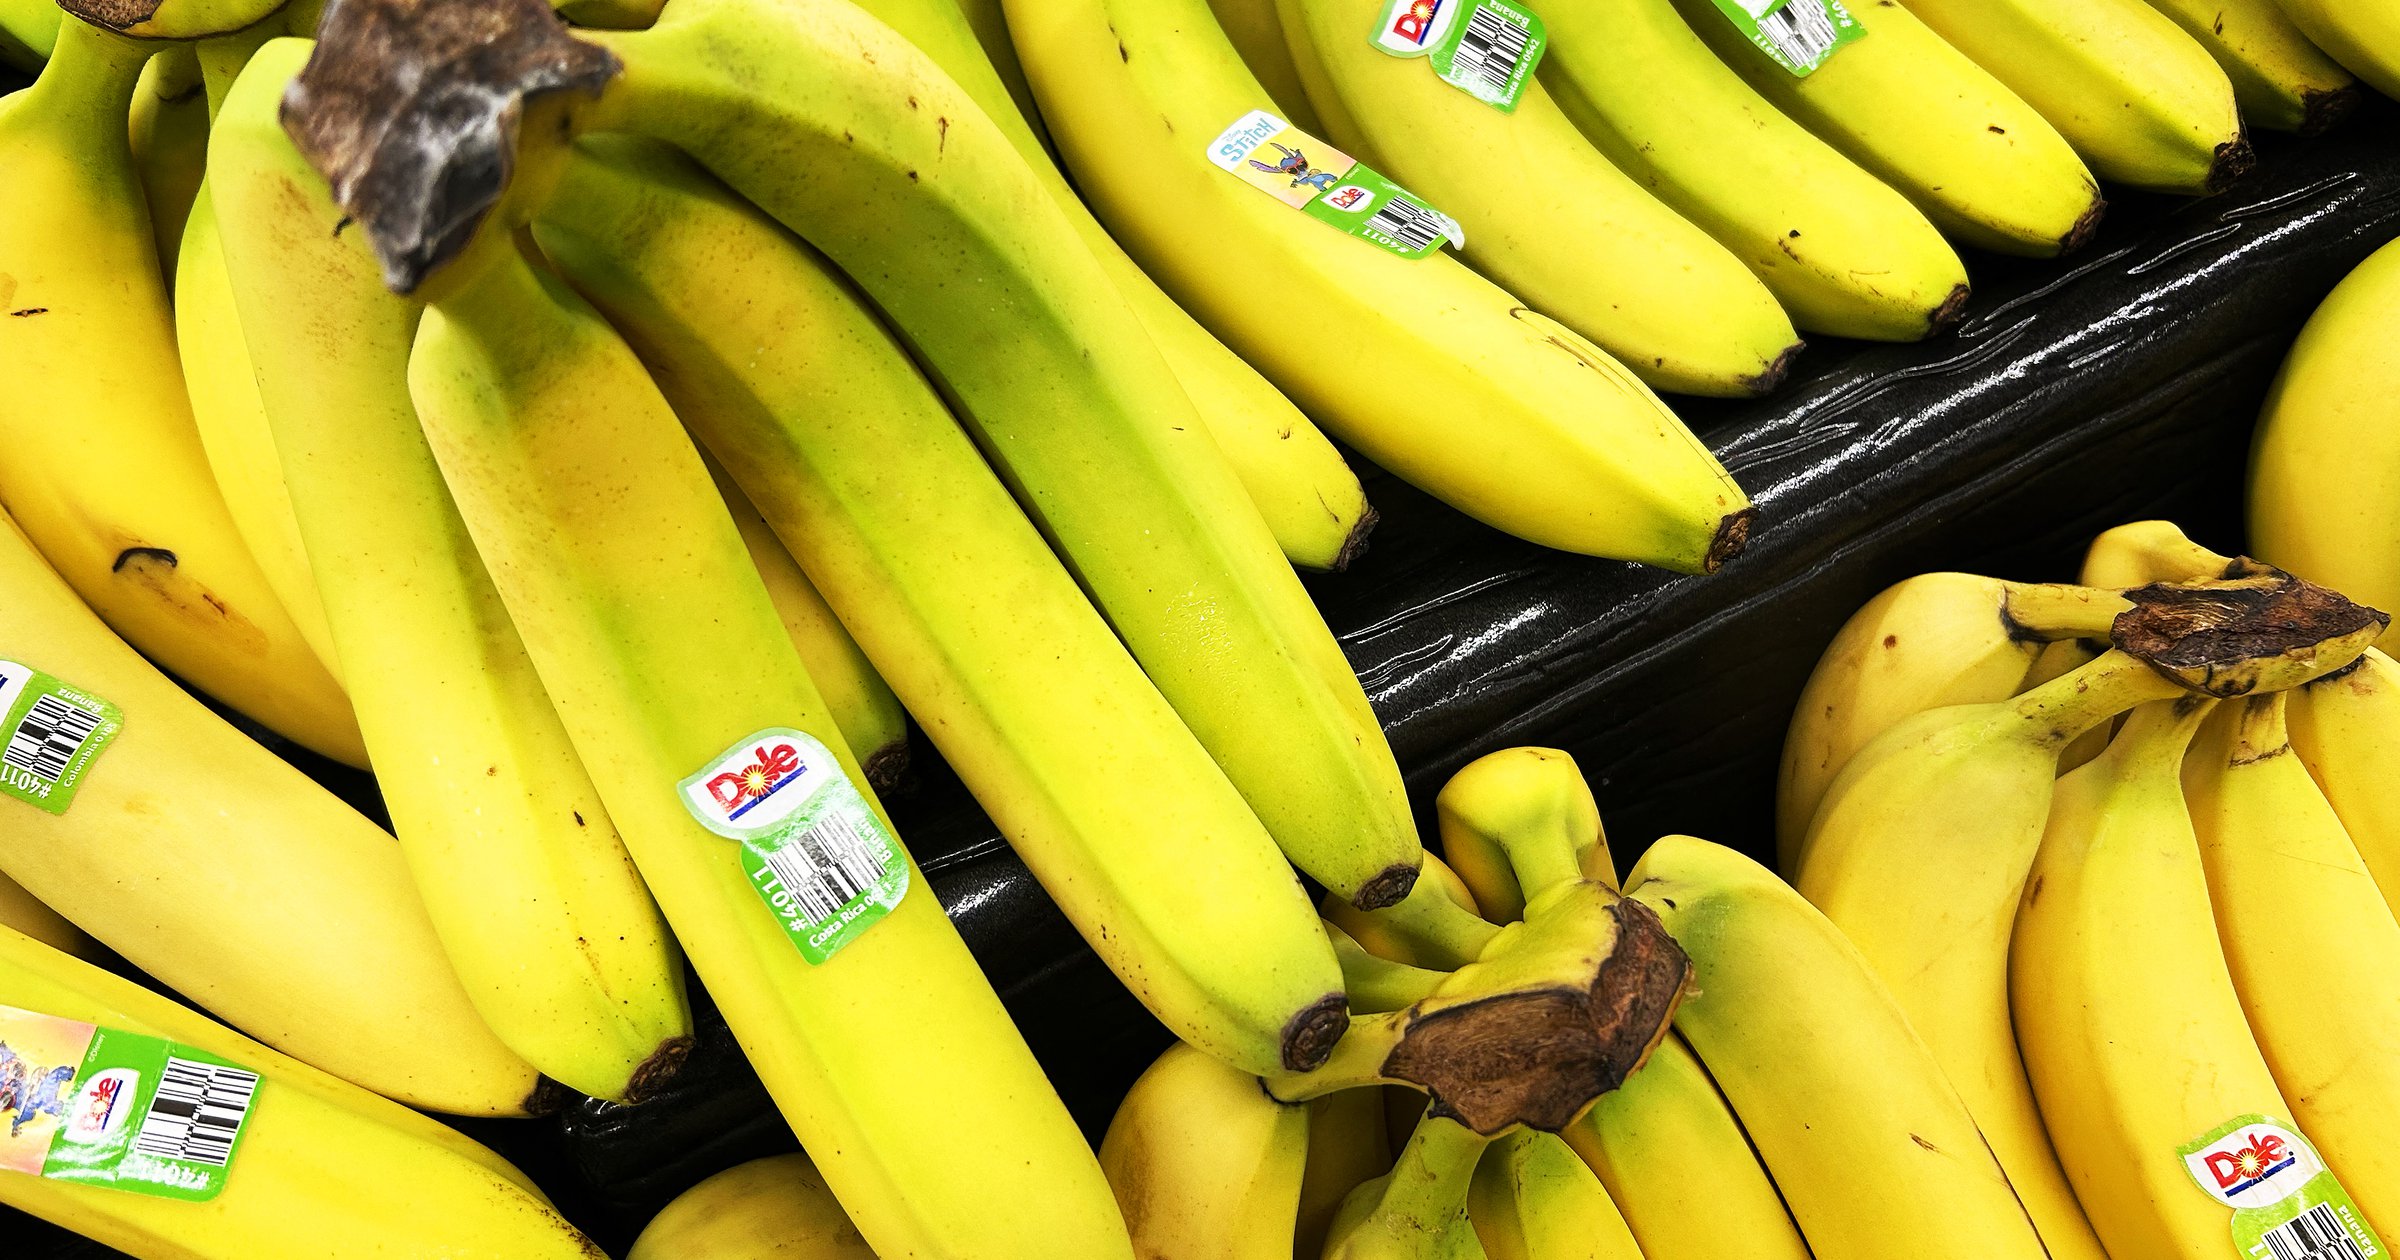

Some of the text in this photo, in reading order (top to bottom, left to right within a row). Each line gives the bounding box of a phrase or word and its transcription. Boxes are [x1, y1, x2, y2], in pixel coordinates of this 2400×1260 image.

[1489, 0, 1530, 28] Banana
[1515, 60, 1529, 82] Rica
[1331, 187, 1361, 208] Dole
[1363, 229, 1409, 253] #4011
[57, 688, 104, 713] Banana
[1, 765, 52, 799] #4011
[64, 742, 98, 787] Colombia
[706, 743, 799, 813] Dole
[753, 866, 809, 932] #4011
[809, 919, 843, 948] Costa
[840, 902, 867, 928] Rica
[2204, 1133, 2288, 1189] Dole
[2338, 1205, 2378, 1258] Banana
